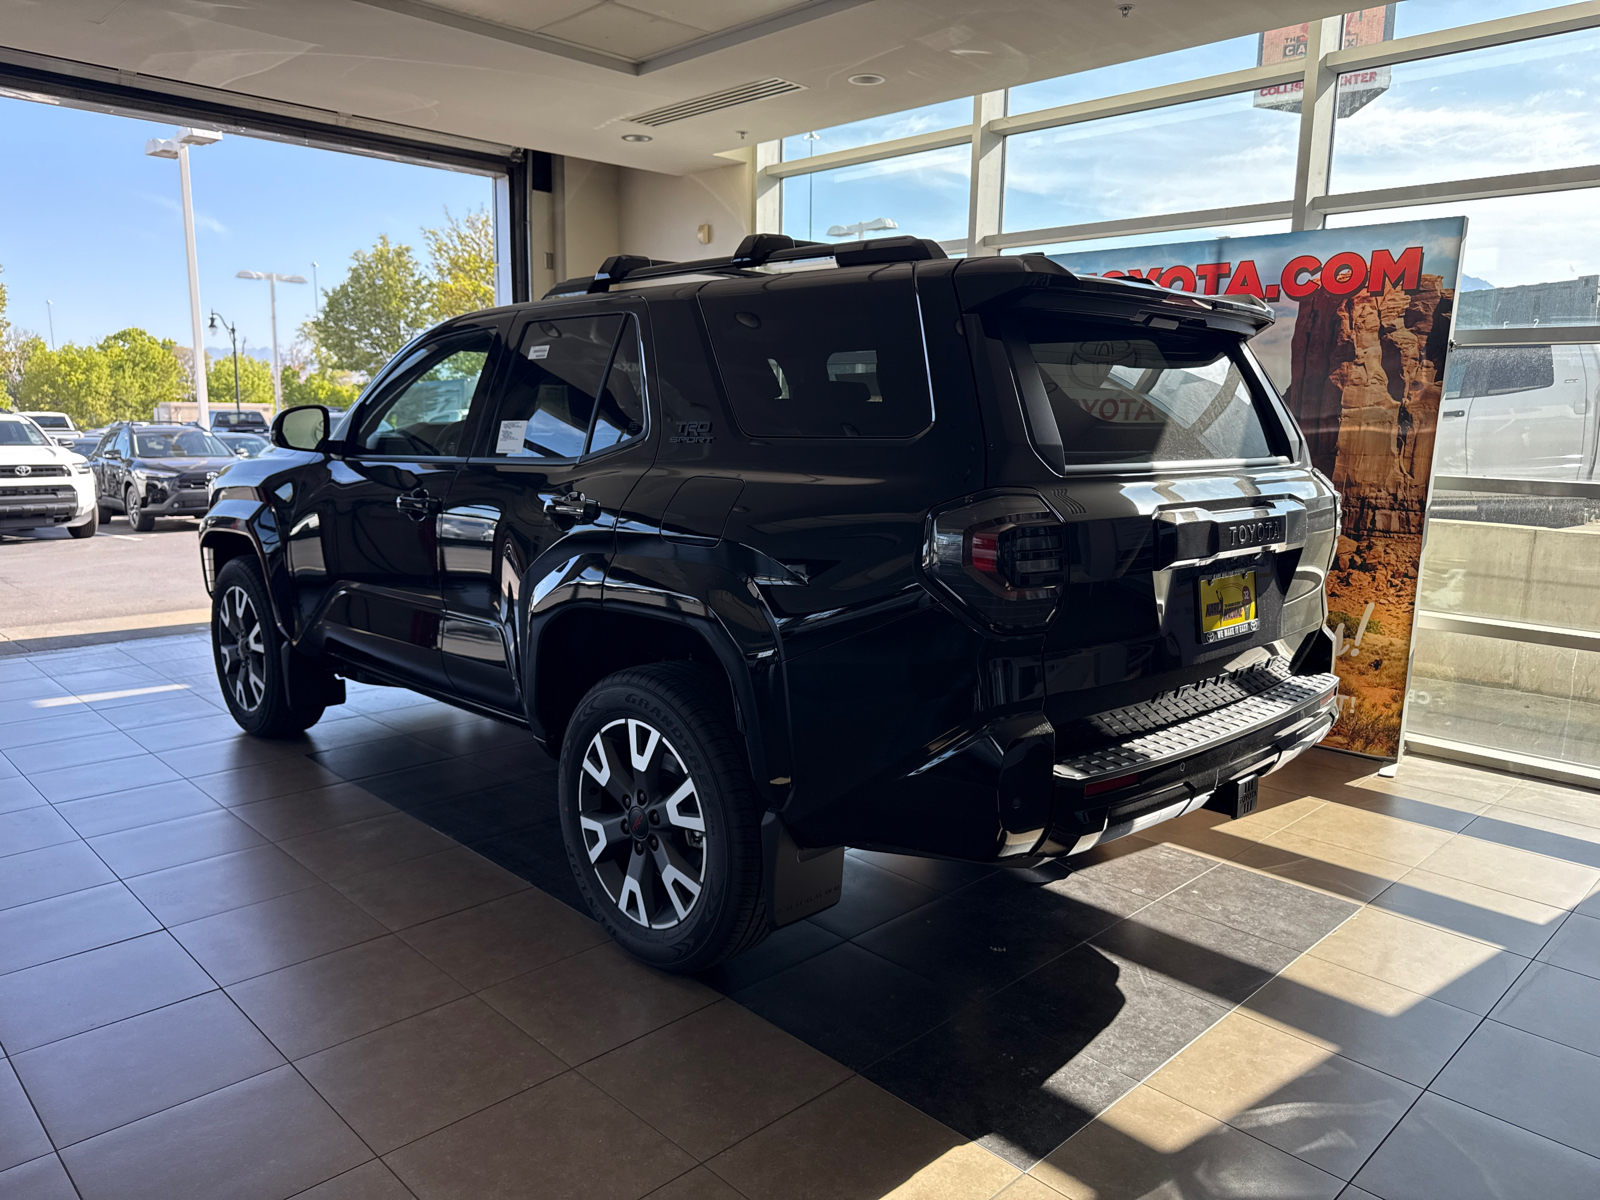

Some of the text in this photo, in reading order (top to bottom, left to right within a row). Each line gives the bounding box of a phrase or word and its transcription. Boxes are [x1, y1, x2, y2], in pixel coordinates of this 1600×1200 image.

[1260, 71, 1377, 97] COLLIS NTER
[675, 420, 712, 437] TRD
[669, 436, 716, 445] SPORT
[1228, 521, 1280, 546] TOYOTA
